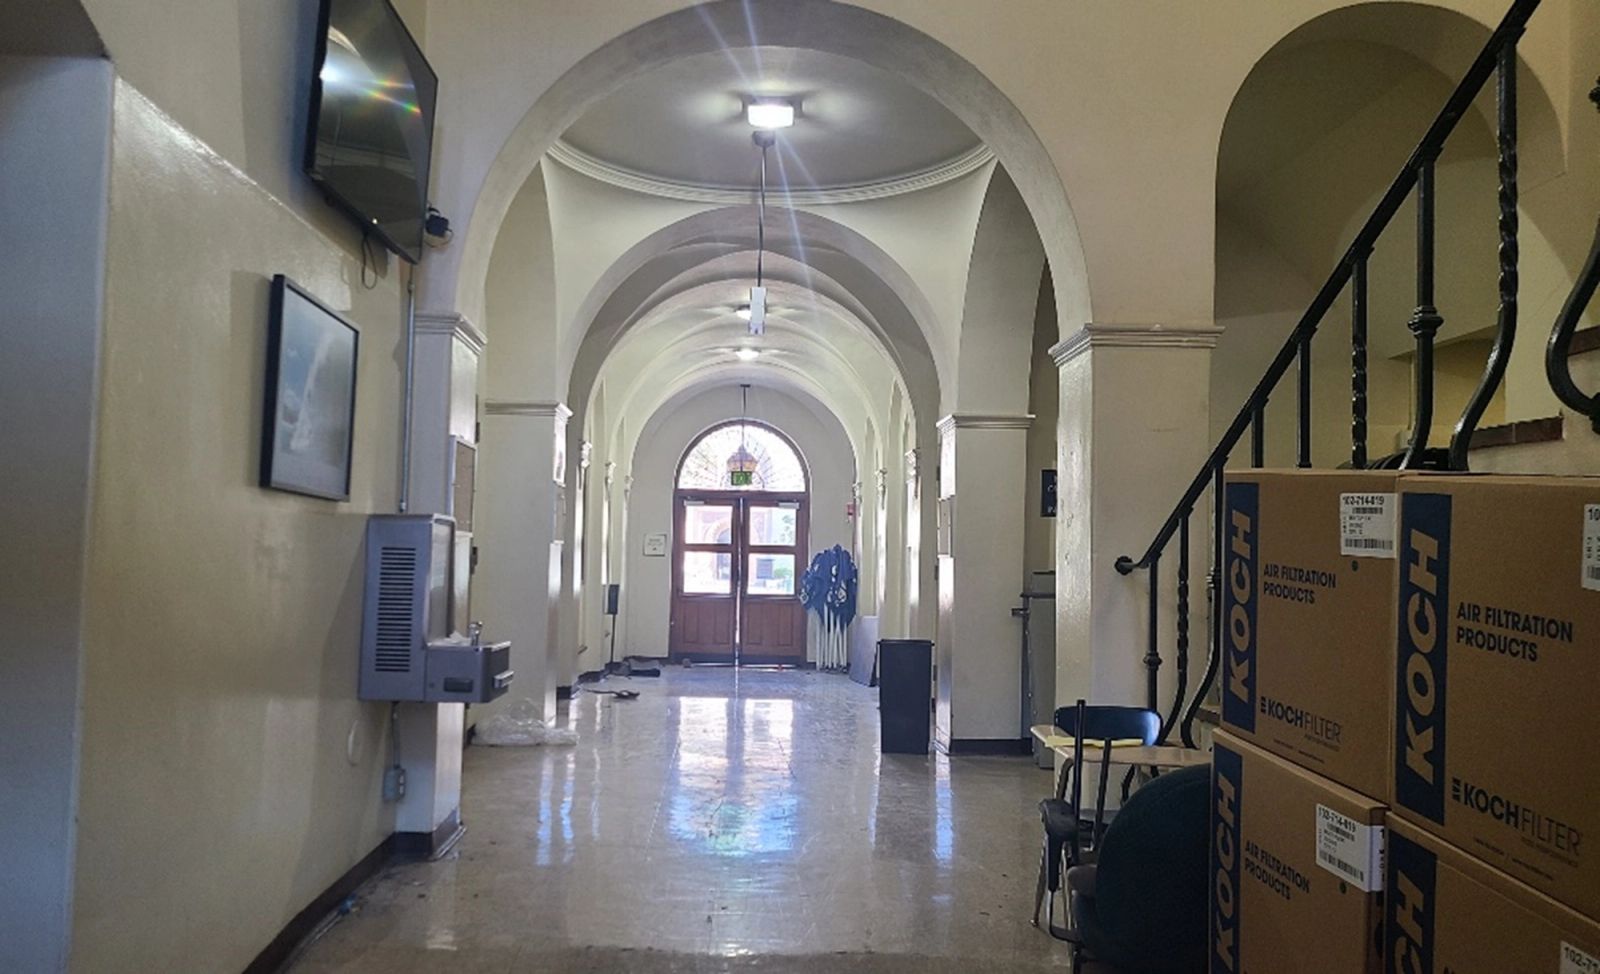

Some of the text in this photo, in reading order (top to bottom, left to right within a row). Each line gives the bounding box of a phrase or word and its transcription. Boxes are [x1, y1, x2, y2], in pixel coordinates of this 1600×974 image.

[1263, 563, 1336, 589] AIR FILTRATION
[1263, 581, 1316, 605] PRODUCTS
[1229, 509, 1251, 704] KOCH
[1456, 602, 1573, 643] AIR FILTRATION
[1406, 528, 1439, 786] KOCH
[1456, 626, 1538, 662] PRODUCTS
[1463, 782, 1581, 857] KOCHFILTER
[1216, 771, 1236, 973] KOCH
[1245, 840, 1310, 894] AIR FILTRATION
[1245, 857, 1291, 901] PRODUCTS
[1394, 868, 1425, 974] CH
